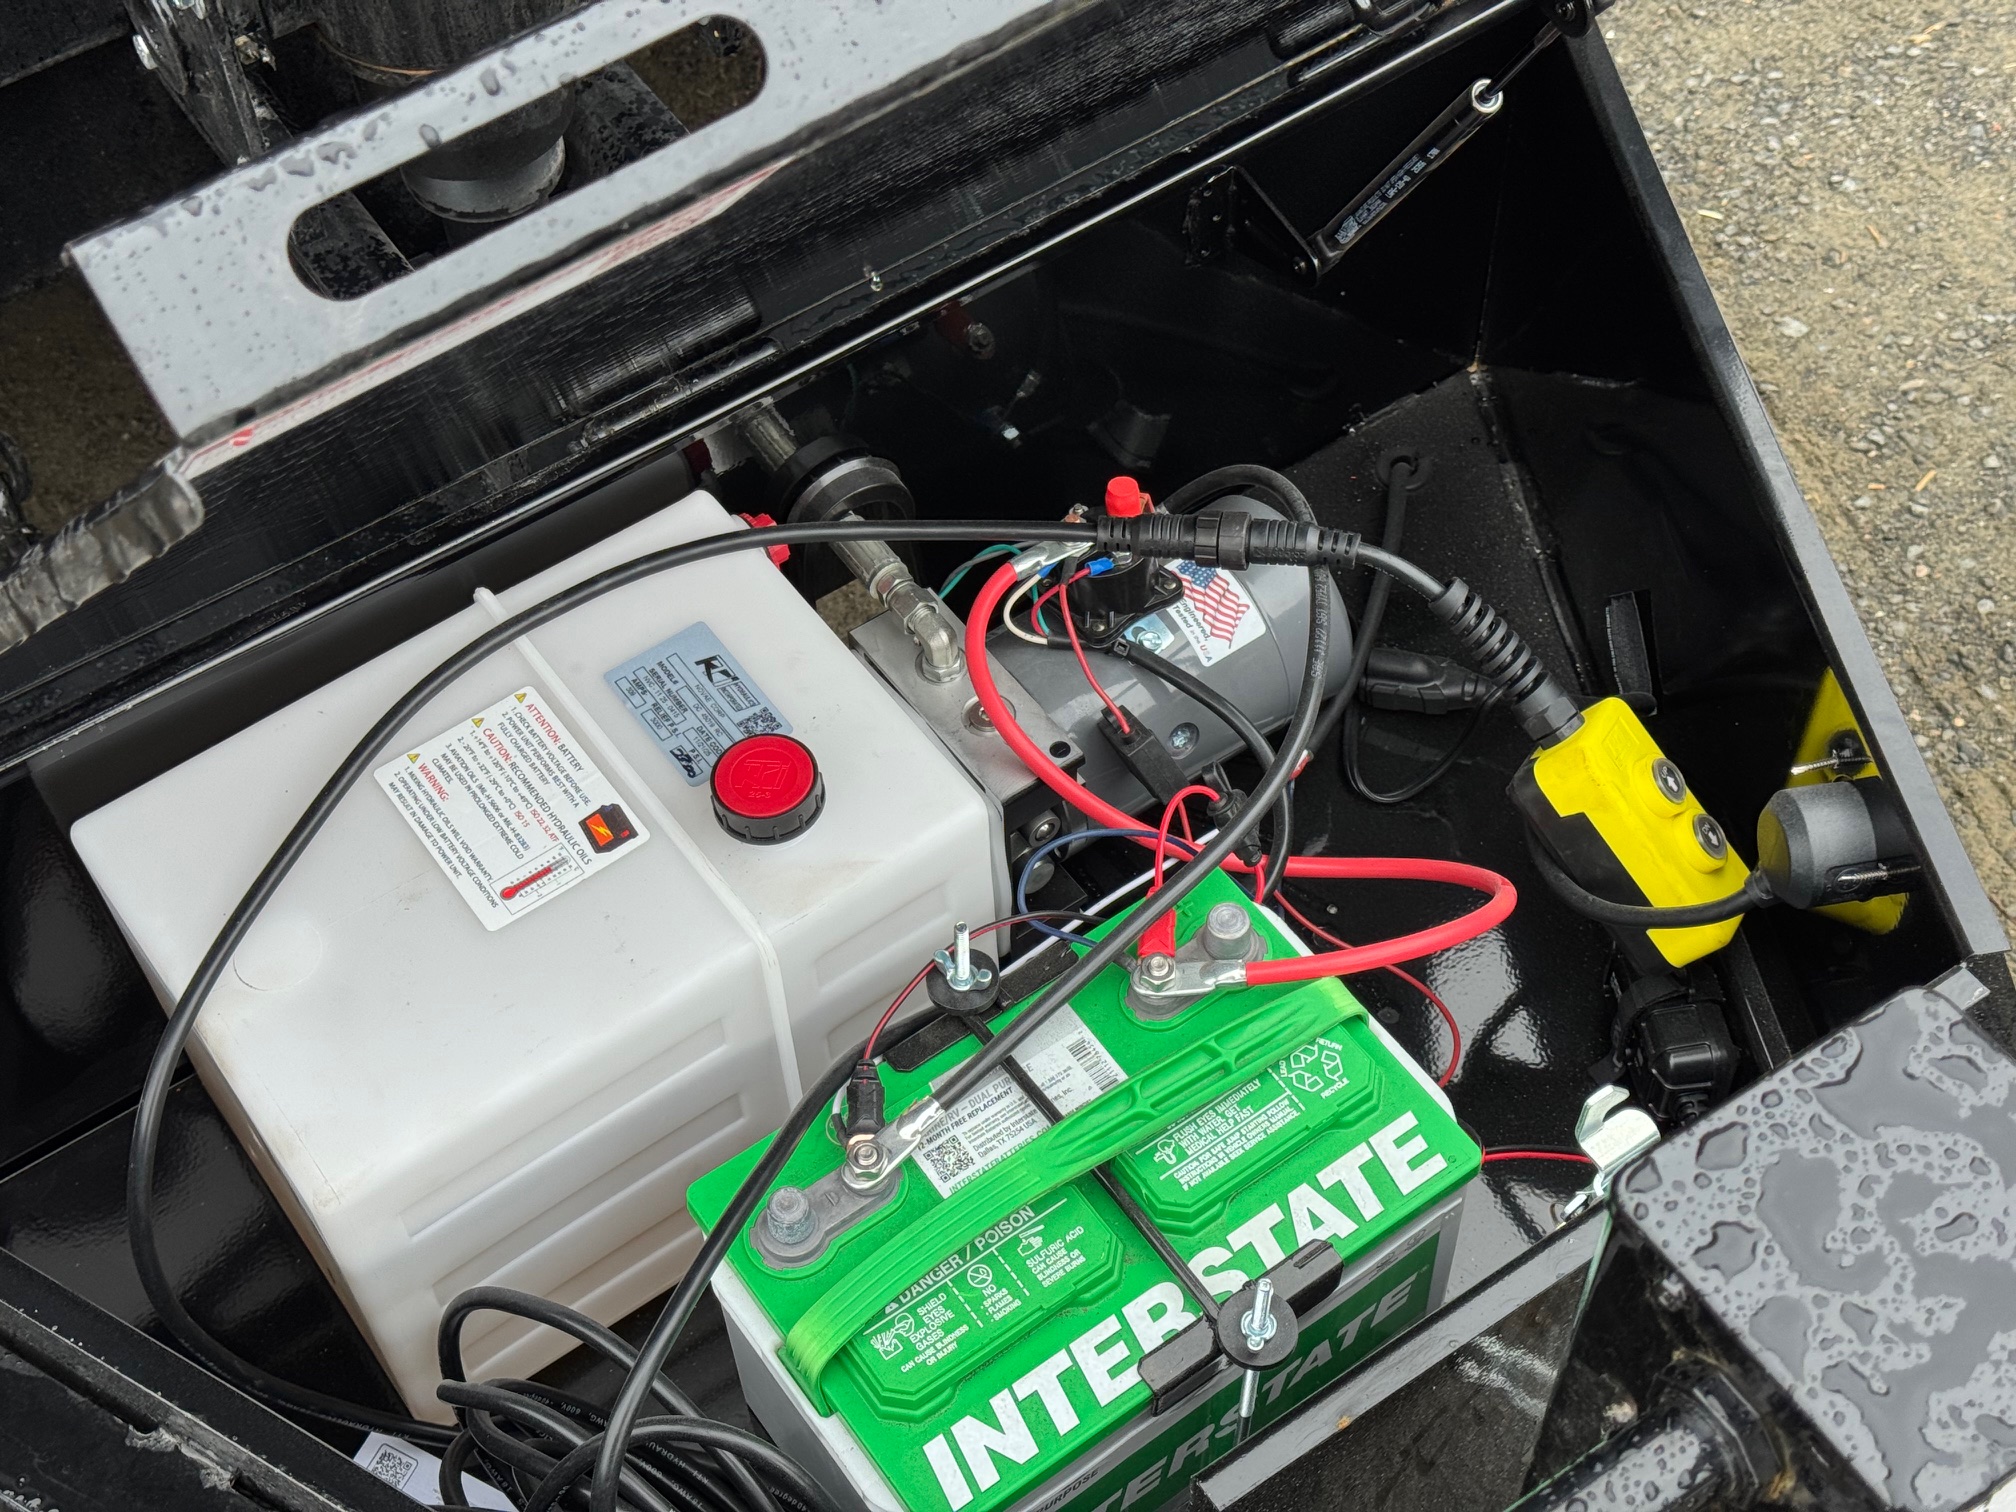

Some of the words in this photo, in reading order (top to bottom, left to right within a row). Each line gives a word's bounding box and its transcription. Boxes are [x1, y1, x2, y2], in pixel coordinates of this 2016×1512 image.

[1173, 605, 1193, 628] Tested
[648, 666, 669, 688] SERIAL
[664, 687, 689, 713] NUMBER
[656, 660, 679, 685] MODEL#
[650, 702, 671, 724] RELIEF
[693, 683, 712, 702] NOVAE
[709, 702, 726, 719] CORP
[524, 701, 562, 745] ATTENTION:
[556, 742, 584, 773] BATTERY
[695, 725, 712, 742] DATE
[430, 757, 454, 784] CLIMATES.
[448, 747, 470, 772] AVIATION
[466, 770, 479, 783] OILS
[496, 721, 513, 738] FULLY
[508, 736, 532, 763] CHARGED
[528, 762, 550, 786] BATTERY
[505, 716, 524, 736] POWER
[519, 735, 533, 749] UNIT
[529, 747, 555, 776] PERFORMS
[551, 774, 565, 789] BEST
[561, 787, 577, 803] WITH
[513, 711, 531, 729] CHECK
[527, 728, 549, 752] BATTERY
[544, 750, 567, 774] VOLTAGE
[562, 772, 582, 794] BEFORE
[578, 792, 592, 806] USE.
[387, 781, 400, 794] MAY
[417, 762, 451, 802] WARNING:
[1661, 766, 1668, 778] UP
[395, 792, 413, 812] RESULT
[440, 752, 453, 765] MAY
[448, 763, 458, 772] BE
[453, 770, 469, 786] USED
[463, 783, 473, 792] IN
[468, 789, 496, 822] PROLONGED
[491, 820, 514, 845] EXTREME
[508, 843, 525, 860] COLD
[470, 754, 480, 762] to
[497, 788, 506, 797] to
[513, 810, 525, 821] ISO
[520, 819, 530, 828] 15
[481, 726, 514, 763] CAUTION:
[507, 760, 552, 813] RECOMMENDED
[546, 810, 581, 850] HYDRAULIC
[575, 847, 592, 865] OILS
[483, 748, 492, 756] to
[511, 785, 521, 793] to
[529, 808, 541, 819] ISO
[547, 831, 559, 843] ATF
[406, 770, 425, 790] MIXING
[420, 788, 445, 818] HYDRAULIC
[440, 816, 454, 829] OILS
[449, 827, 462, 841] WILL
[458, 839, 472, 854] VOID
[467, 852, 493, 883] WARRANTY.
[409, 810, 418, 818] IN
[413, 816, 434, 840] DAMAGE
[1702, 822, 1711, 834] DN
[396, 775, 422, 805] OPERATING
[417, 803, 435, 822] UNDER
[430, 820, 444, 834] LOW
[439, 832, 459, 855] BATTERY
[454, 853, 476, 877] VOLTAGE
[471, 875, 499, 909] CONDITIONS
[429, 838, 439, 847] TO
[434, 845, 452, 865] POWER
[448, 863, 462, 879] UNIT.
[1315, 1037, 1343, 1052] RETURN
[1279, 1060, 1287, 1077] LEAD
[968, 1088, 993, 1108] DUAL
[1320, 1077, 1350, 1099] RECYCLE
[950, 1115, 967, 1130] FREE
[966, 1086, 1013, 1119] REPLACEMENT
[1171, 1121, 1198, 1143] FLUSH
[1195, 1108, 1217, 1127] EYES
[1214, 1077, 1261, 1114] IMMEDIATELY
[972, 1128, 1004, 1152] Distributed
[1010, 1107, 1038, 1128] Interstate
[977, 1141, 998, 1158] Dallas,
[996, 1136, 1006, 1146] TX
[1022, 1116, 1037, 1129] USA
[1178, 1131, 1200, 1149] WITH
[1223, 1102, 1241, 1119] GET
[1184, 1130, 1217, 1156] MEDICAL
[1214, 1117, 1236, 1136] HELP
[1234, 1104, 1254, 1122] FAST
[1197, 1150, 1212, 1163] FOR
[1209, 1140, 1226, 1155] SAFE
[1223, 1130, 1242, 1146] JUMP
[1239, 1112, 1268, 1135] STARTING
[1265, 1097, 1290, 1117] FOLLOW
[1177, 1155, 1218, 1186] INSTRUCTIONS
[1222, 1134, 1247, 1155] VEHICLE
[1245, 1120, 1269, 1140] OWNERS
[1188, 1174, 1203, 1187] NOT
[1200, 1155, 1230, 1179] AVAILABLE
[1228, 1145, 1245, 1160] SEEK
[1242, 1130, 1267, 1150] SERVICE
[897, 1253, 963, 1304] DANGER
[973, 1203, 1035, 1252] POISON
[1024, 1237, 1065, 1268] SULFURIC
[1062, 1224, 1085, 1243] ACID
[1030, 1261, 1047, 1275] CAN
[1044, 1246, 1068, 1265] CAUSE
[1036, 1254, 1071, 1281] BLINDNESS
[1068, 1247, 1081, 1259] OR
[1040, 1267, 1066, 1288] SEVERE
[1063, 1254, 1086, 1272] BURNS
[915, 1291, 947, 1316] SHIELD
[981, 1282, 998, 1297] NO
[981, 1286, 1009, 1308] SPARKS
[986, 1294, 1013, 1314] FLAMES
[908, 1308, 955, 1344] EXPLOSIVE
[922, 1304, 946, 1324] EYES
[992, 1297, 1022, 1321] SMOKING
[900, 1359, 915, 1373] CAN
[913, 1345, 936, 1364] CAUSE
[934, 1323, 969, 1350] BLINDNESS
[914, 1327, 945, 1352] GASES
[925, 1355, 937, 1366] OR
[935, 1340, 959, 1360] INJURY
